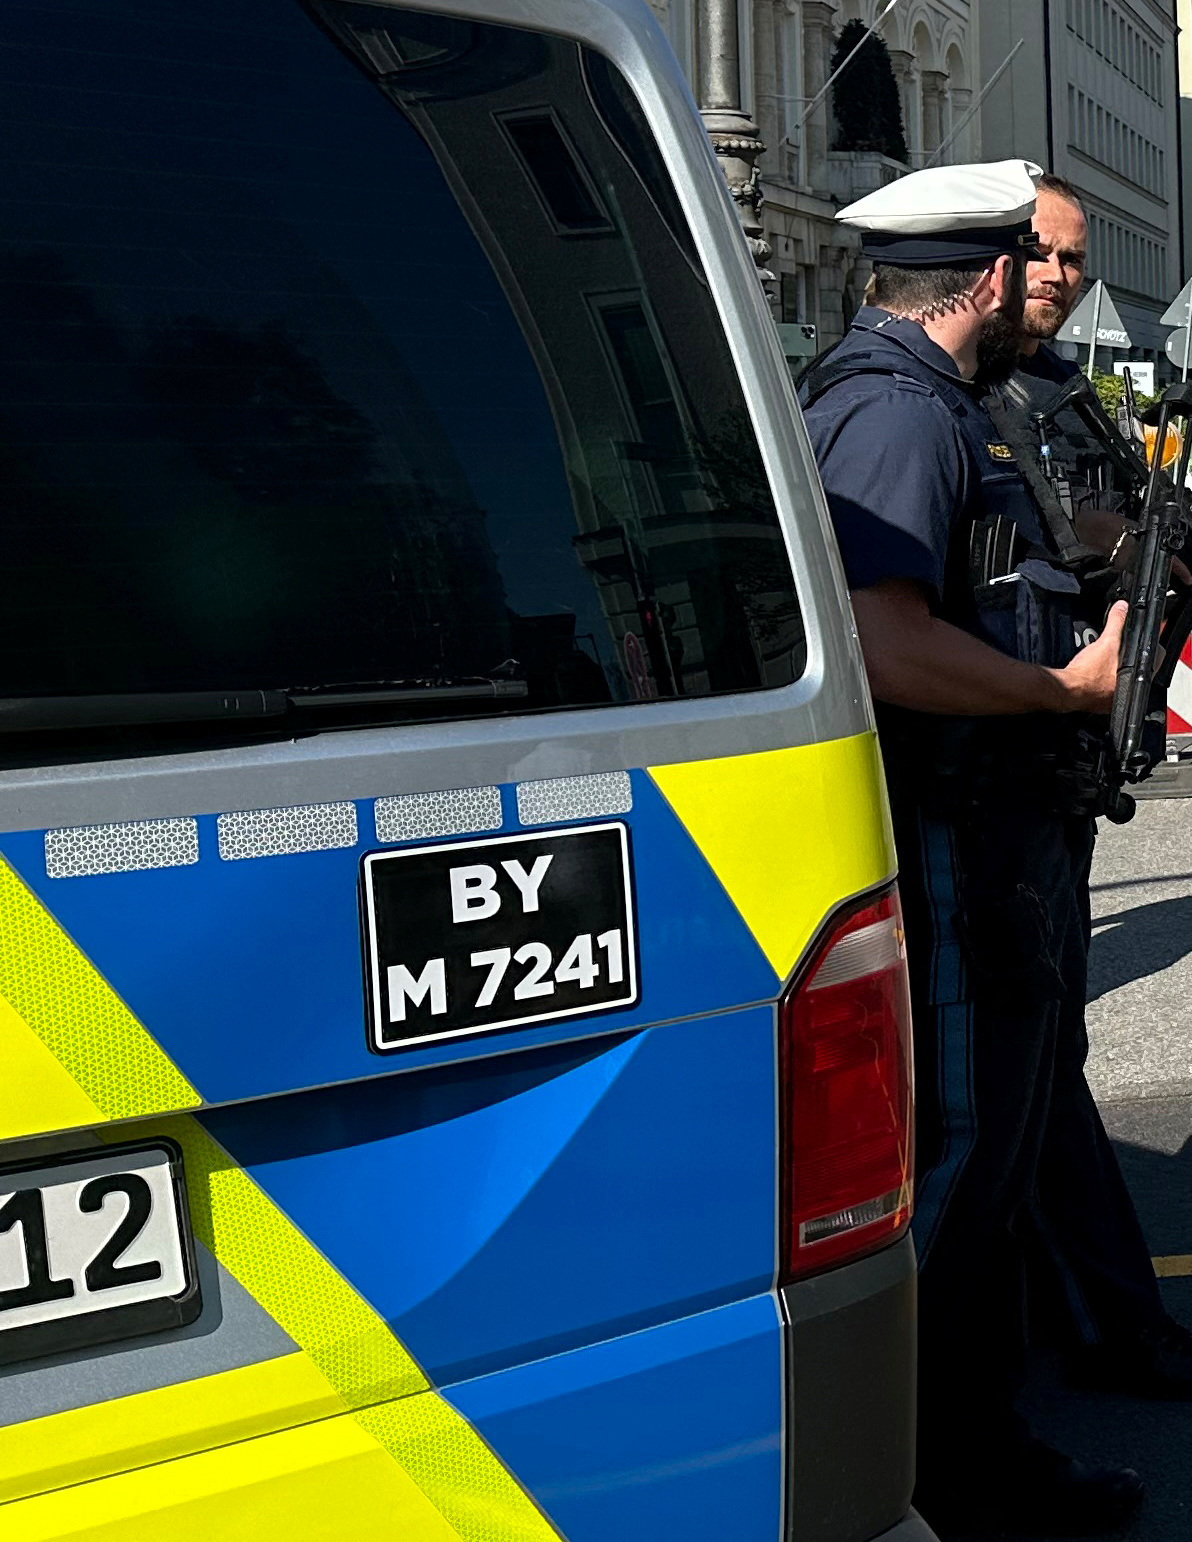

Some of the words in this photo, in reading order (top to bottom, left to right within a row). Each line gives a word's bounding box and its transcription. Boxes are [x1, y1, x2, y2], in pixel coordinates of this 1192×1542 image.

[450, 854, 554, 924] BY
[387, 957, 448, 1023] M
[470, 929, 624, 1008] 7241
[0, 1173, 162, 1312] 12
